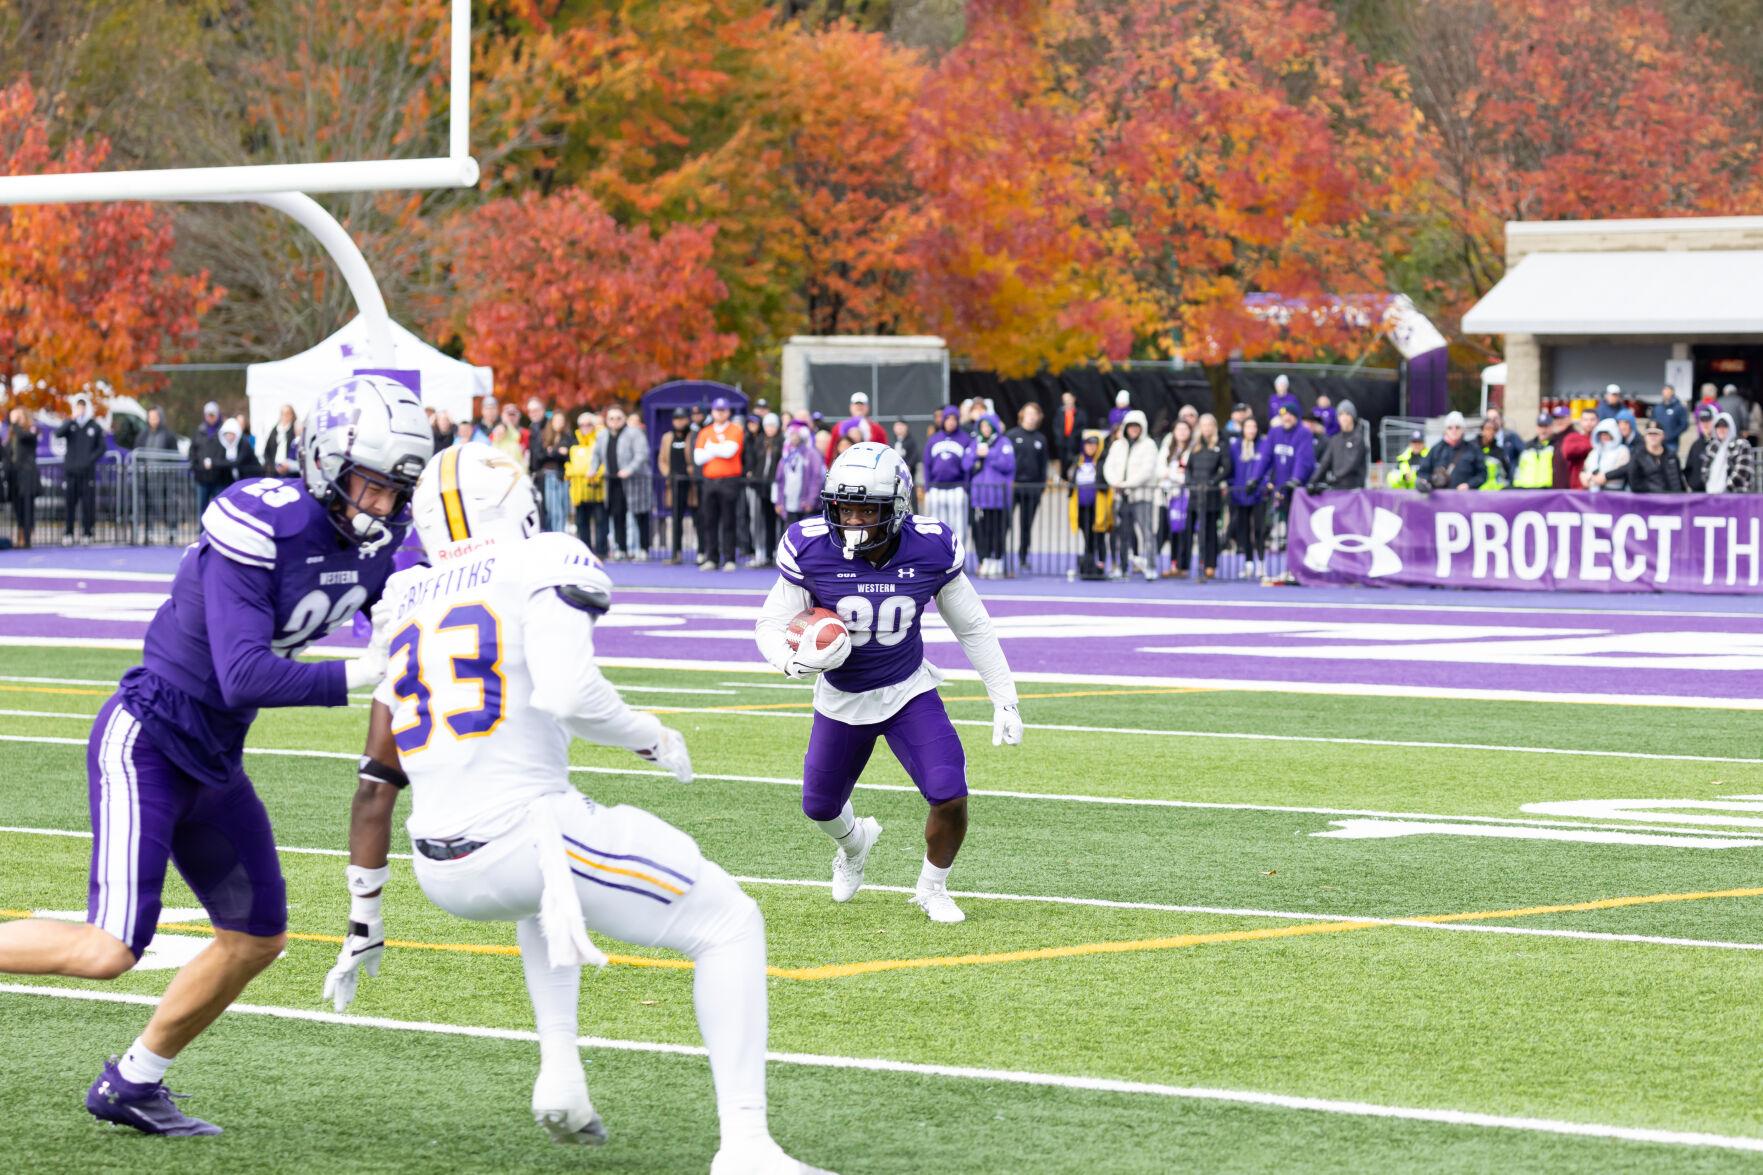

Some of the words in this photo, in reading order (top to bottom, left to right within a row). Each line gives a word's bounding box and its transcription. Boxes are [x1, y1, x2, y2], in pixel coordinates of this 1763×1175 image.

[1435, 510, 1681, 583] PROTECT
[1693, 516, 1760, 586] TH
[857, 583, 896, 593] WESTERN
[836, 595, 917, 647] 80
[389, 600, 507, 757] 33
